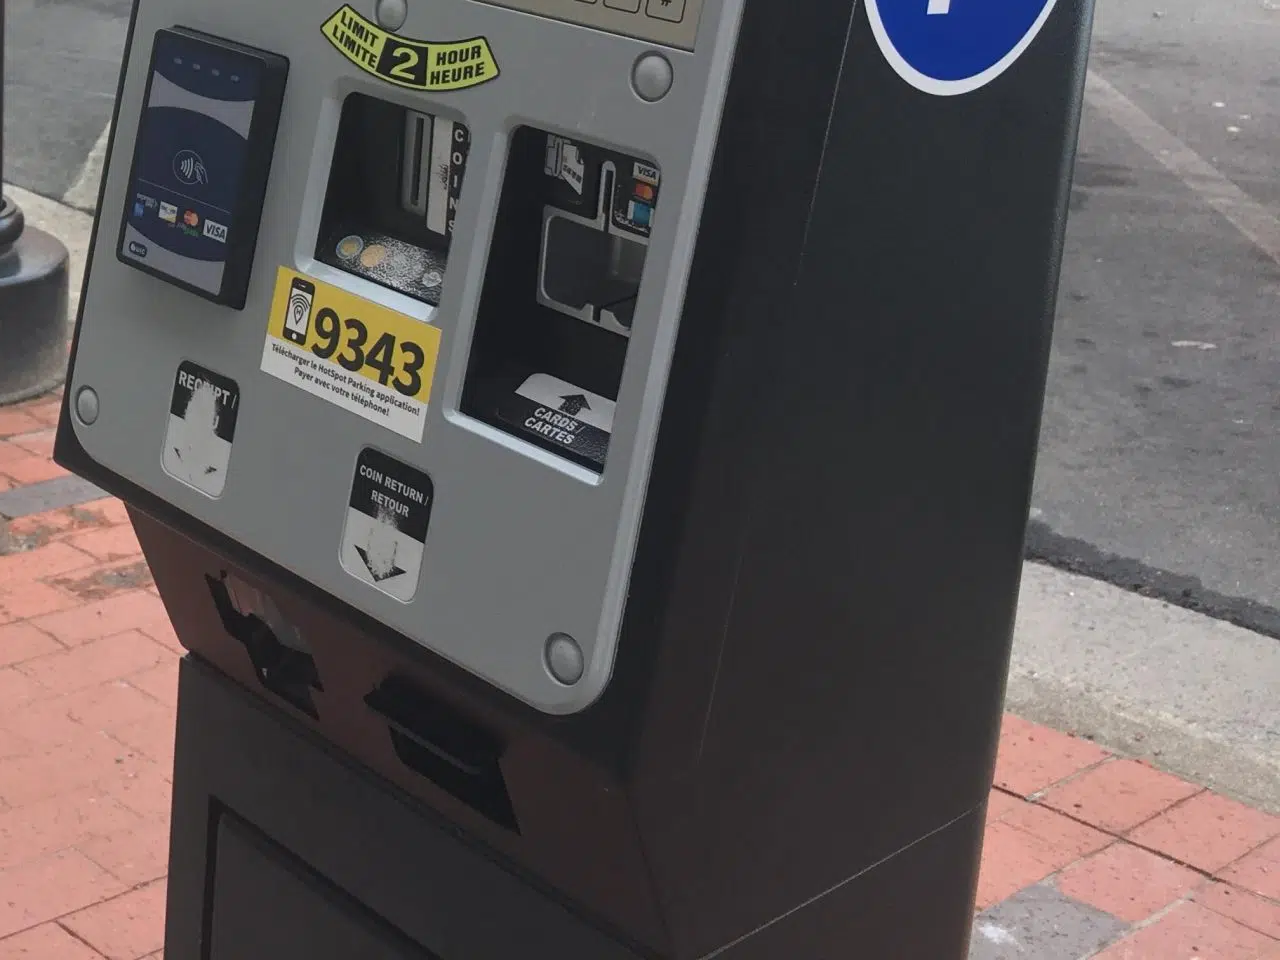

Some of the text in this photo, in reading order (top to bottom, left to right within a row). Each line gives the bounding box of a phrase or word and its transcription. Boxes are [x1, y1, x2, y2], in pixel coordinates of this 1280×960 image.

[332, 24, 485, 85] LIMITE HEURE
[340, 11, 482, 81] LIMIT 2 HOUR
[637, 165, 657, 180] VISA
[206, 224, 226, 240] VISA
[311, 307, 425, 397] 9343
[272, 343, 420, 417] Télécharger le HotSpot Parking application!
[294, 367, 390, 416] Payer avec votre téléphone!
[524, 417, 575, 445] CARTES
[534, 407, 578, 431] CARDS
[360, 465, 383, 484] COIN
[384, 476, 423, 504] RETURN
[370, 490, 409, 517] RETOUR
